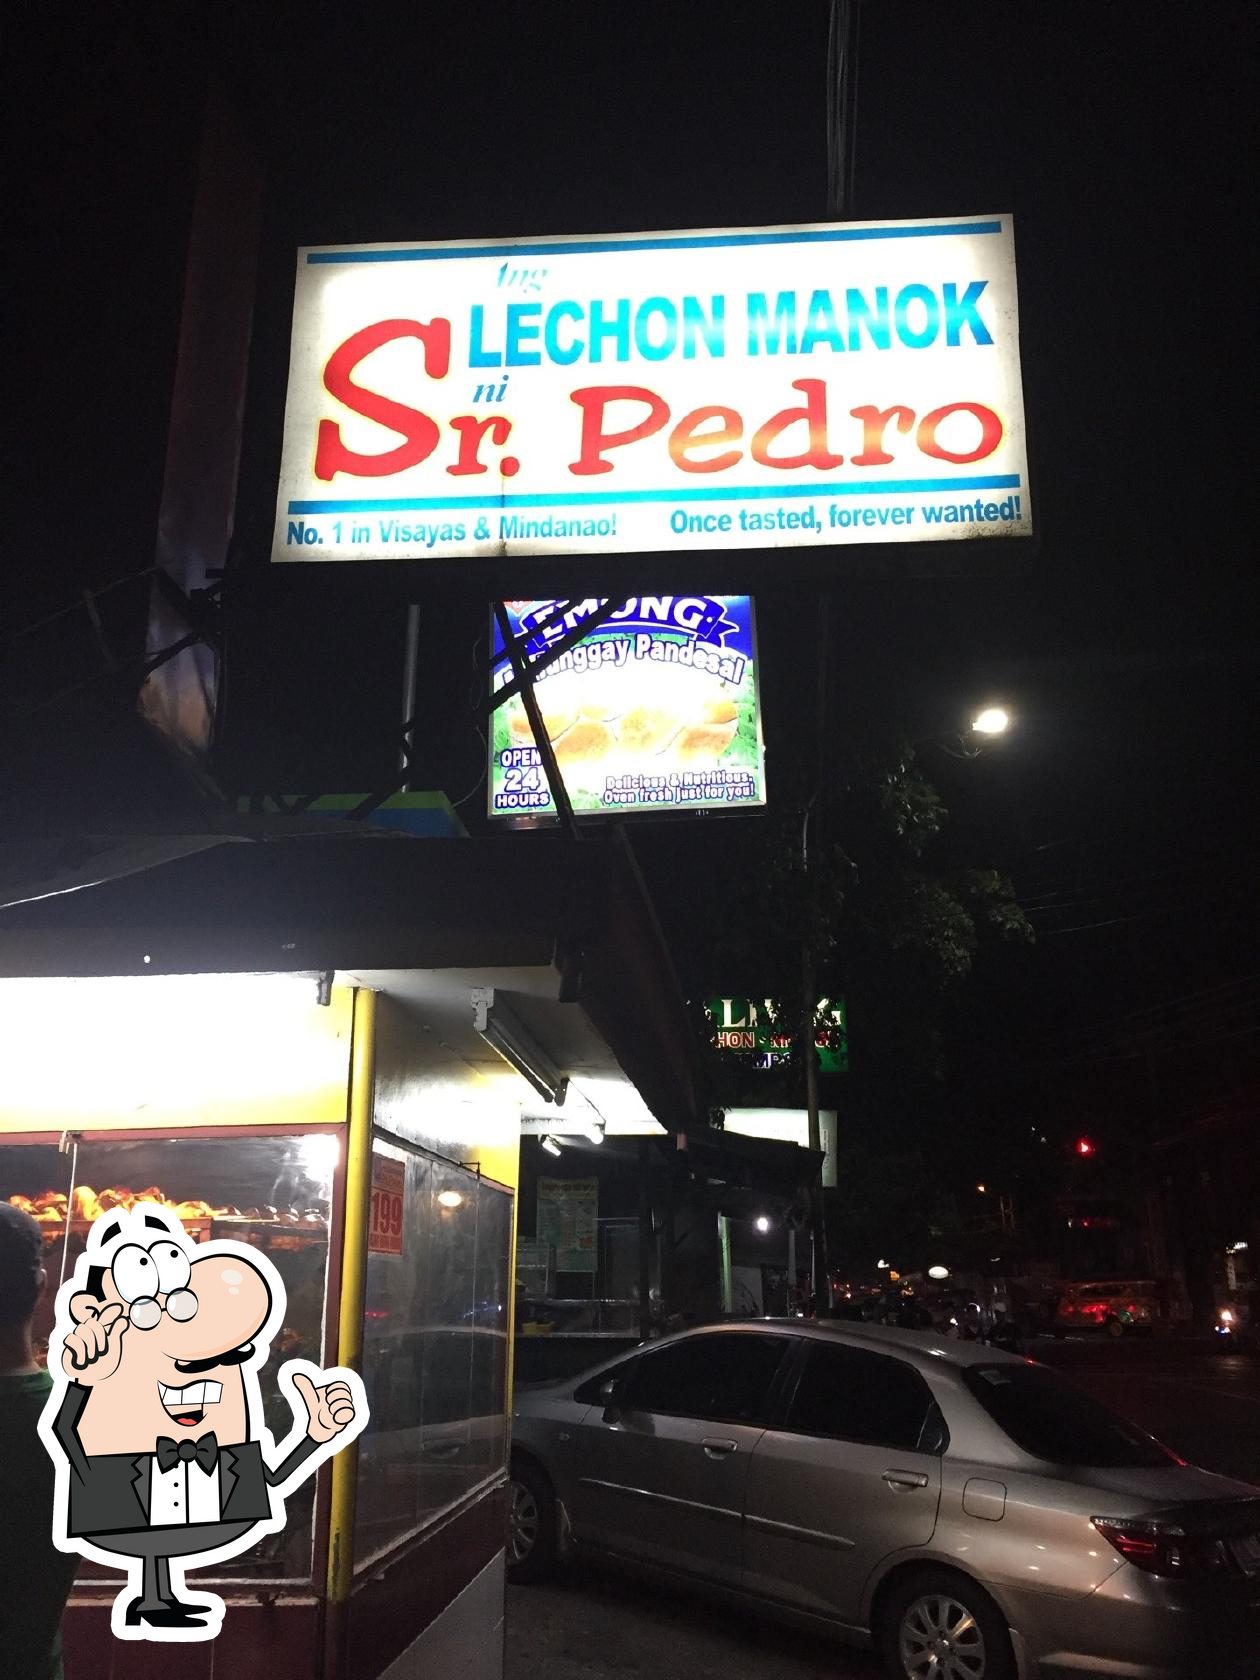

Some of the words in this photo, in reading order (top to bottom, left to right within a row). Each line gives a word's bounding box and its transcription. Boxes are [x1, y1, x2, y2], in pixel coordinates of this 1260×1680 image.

[468, 296, 725, 368] LECHON
[747, 281, 995, 356] MANOK
[314, 317, 521, 481] Sr.
[567, 378, 1004, 476] Pedro
[473, 374, 509, 404] ni
[287, 521, 324, 545] No.
[332, 523, 343, 543] 1
[351, 519, 371, 543] in
[379, 517, 466, 548] Visayas
[473, 516, 491, 540] &
[499, 513, 617, 539] Mindanao!
[670, 508, 732, 534] Once
[739, 504, 822, 533] tasted,
[829, 501, 915, 528] forever
[921, 496, 1022, 523] wanted!
[635, 633, 746, 685] Pandesal
[500, 748, 542, 768] OPEN
[505, 767, 541, 792] 24
[604, 789, 638, 804] Oven
[640, 787, 673, 803] fresh
[675, 785, 701, 804] just
[704, 785, 724, 800] for
[726, 783, 756, 801] you!
[605, 775, 666, 791] Delicious
[669, 773, 681, 788] &
[496, 792, 550, 808] HOURS
[371, 1191, 403, 1236] 199
